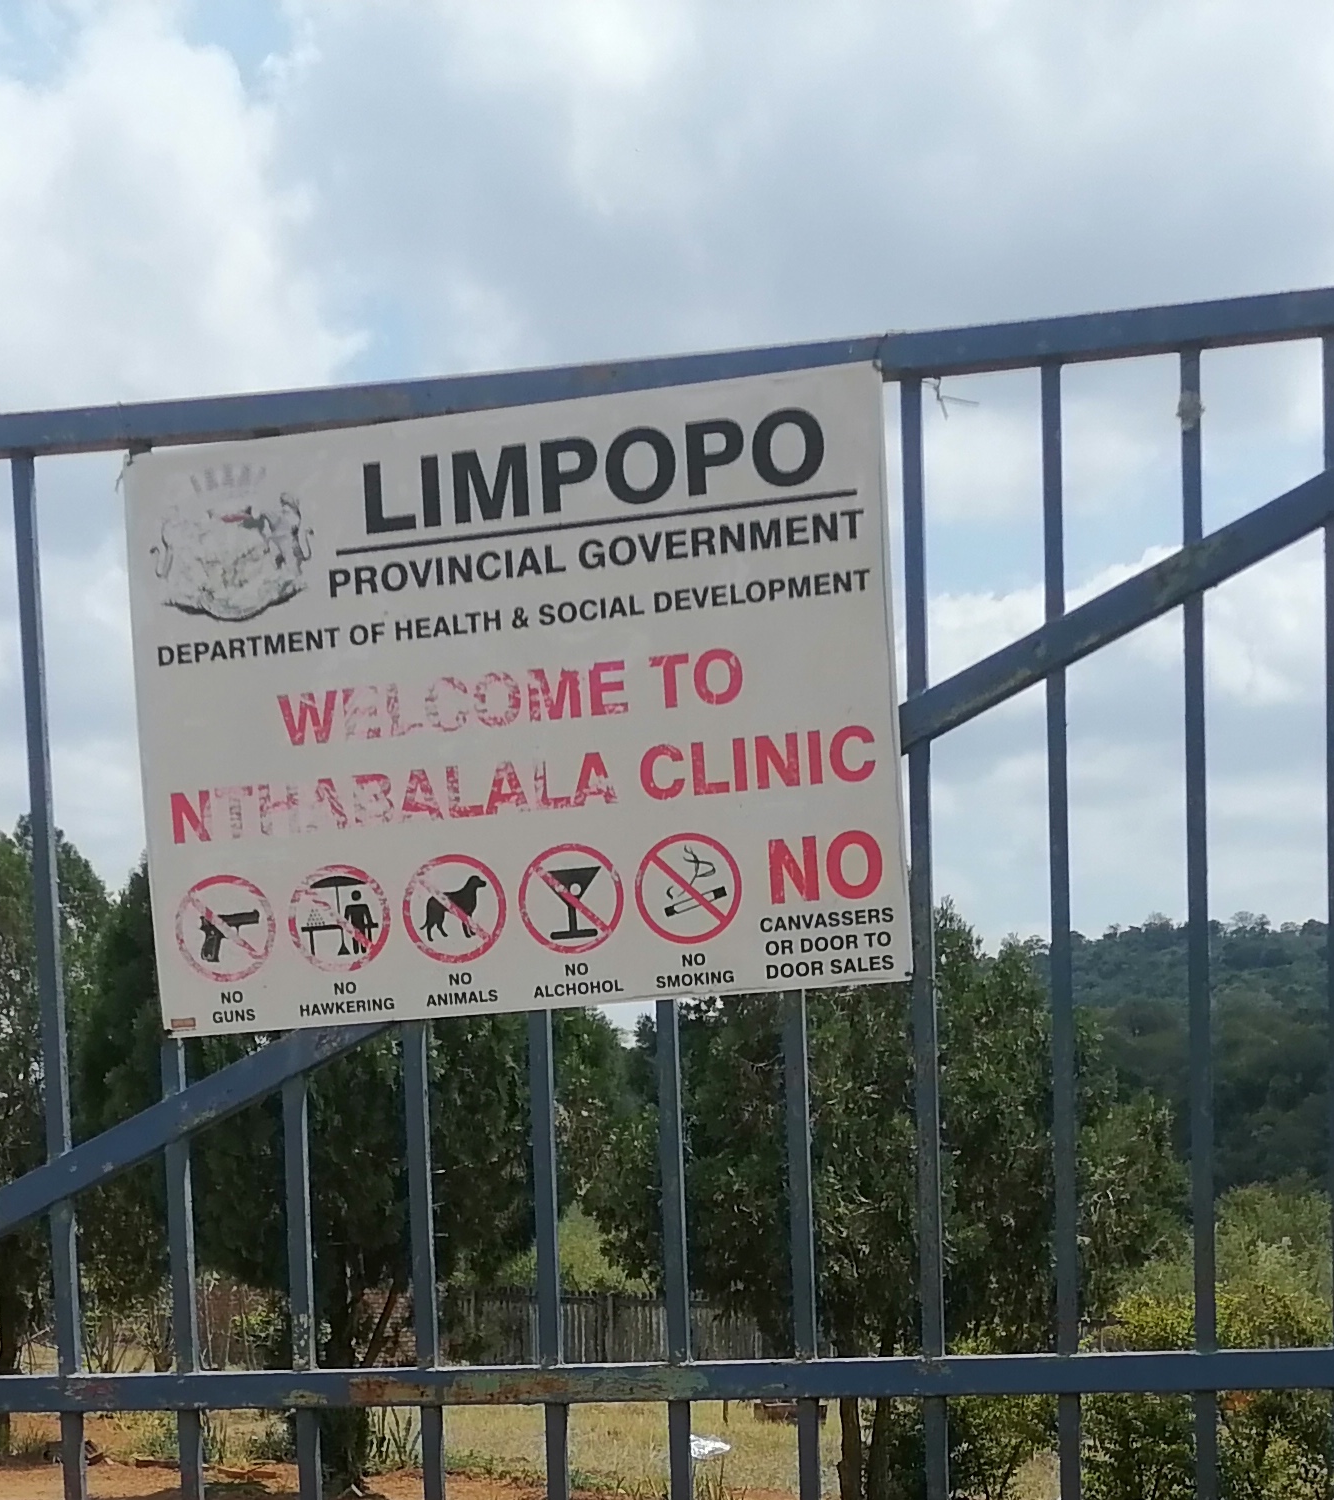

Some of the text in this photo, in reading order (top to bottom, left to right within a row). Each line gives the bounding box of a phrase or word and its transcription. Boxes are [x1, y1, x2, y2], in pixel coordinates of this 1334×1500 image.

[363, 408, 825, 536] LIMPOPO
[328, 509, 865, 600] PROVINCIAL GOVERNMENT
[157, 569, 872, 667] DEPARTMENT OF HEALTH & SOCIAL DEVELOPMENT
[277, 648, 744, 746] WELCOME TO
[170, 725, 876, 845] NTHABALALA CLINIC
[767, 829, 884, 905] NO
[759, 907, 895, 933] CANVASSERS
[765, 931, 892, 957] OR DOOR TO
[564, 962, 589, 977] NO
[681, 952, 706, 968] NO
[765, 955, 895, 980] DOOR SALES
[333, 981, 358, 996] NO
[448, 972, 473, 987] NO
[533, 979, 625, 998] ALCHOHOL
[655, 969, 735, 989] SMOKING
[220, 990, 245, 1005] NO
[299, 997, 396, 1017] HAWKERING
[426, 989, 499, 1007] ANIMALS
[212, 1008, 256, 1024] GUNS
